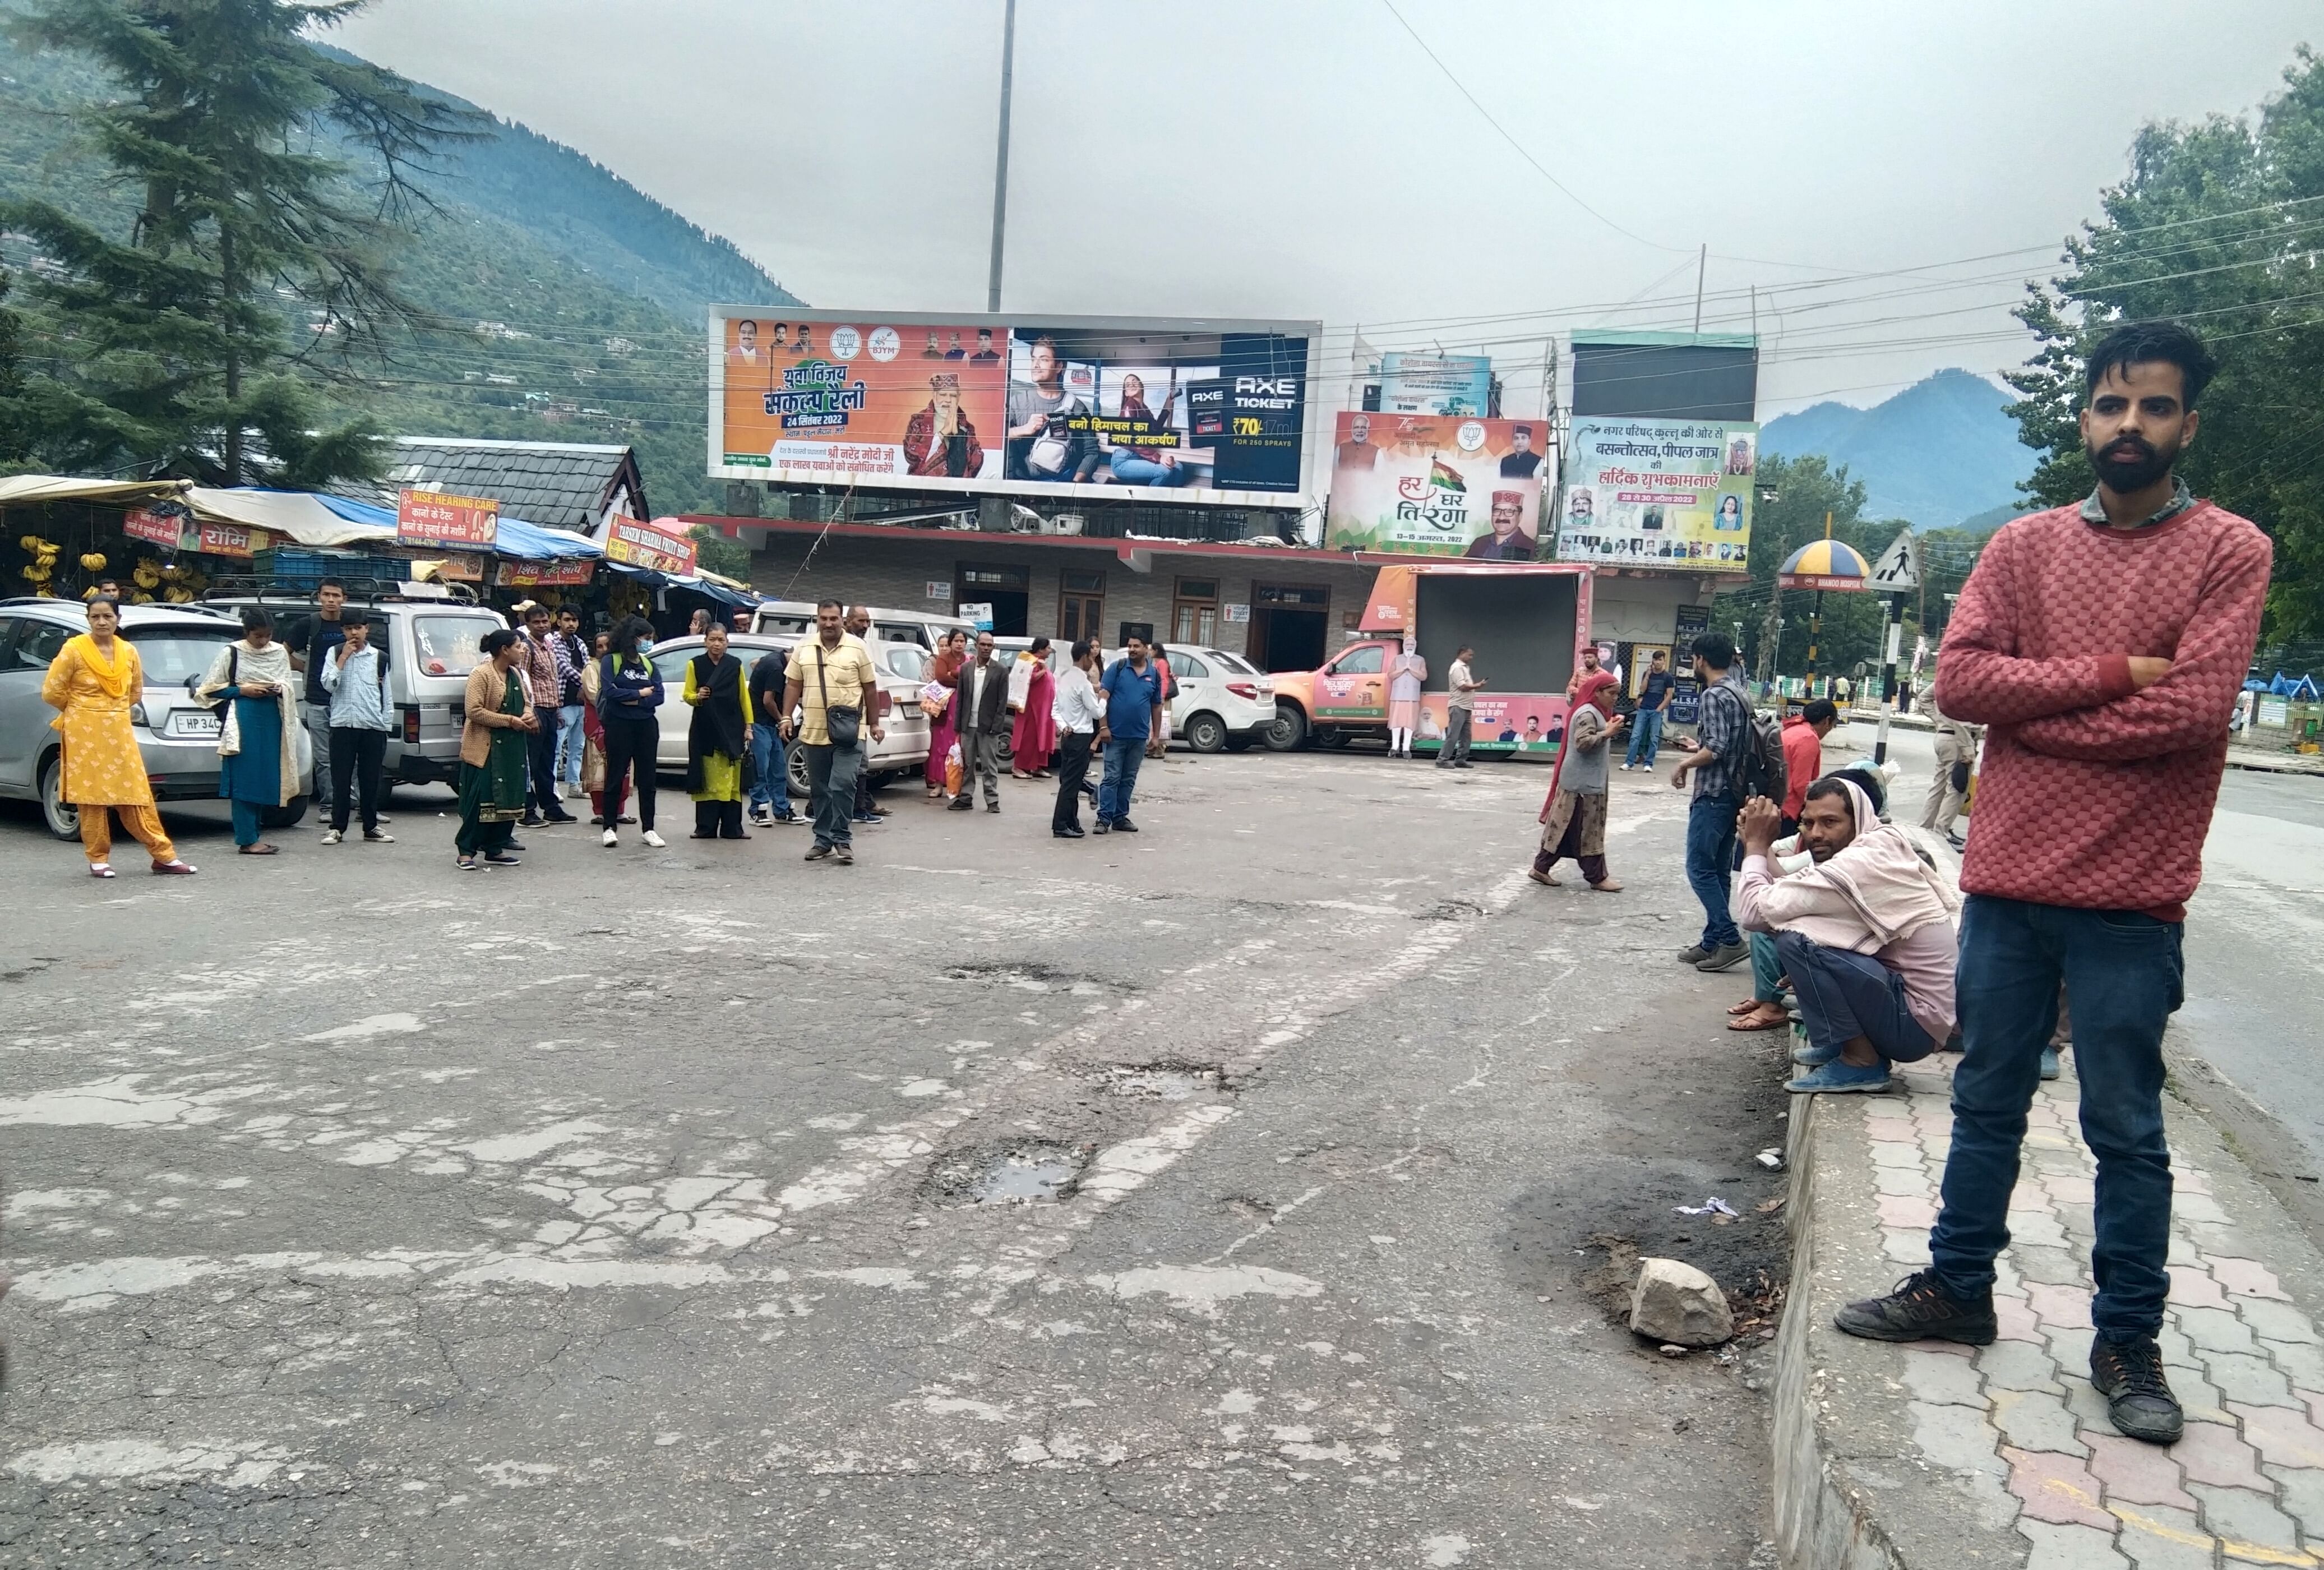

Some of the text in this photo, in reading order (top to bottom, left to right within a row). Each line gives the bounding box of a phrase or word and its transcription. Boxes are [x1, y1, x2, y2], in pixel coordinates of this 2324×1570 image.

[782, 361, 849, 390] युवा विजय
[1235, 377, 1296, 395] AXE
[763, 379, 867, 415] संकल्प रैली
[1192, 391, 1224, 403] AXE
[1235, 398, 1295, 409] TICKET
[787, 414, 843, 427] 24 सितंबर 2022
[1068, 417, 1148, 432] बनो हिमाचल का
[1111, 433, 1177, 446] नया आकर्षण
[1604, 426, 1624, 436] नगर
[1655, 428, 1679, 441] कुल्लू
[1681, 425, 1694, 438] की
[1695, 426, 1713, 439] ओर
[1715, 427, 1724, 439] से
[1399, 440, 1414, 449] अमृत
[1662, 442, 1694, 459] पीपल
[1695, 446, 1720, 459] जात्र
[828, 445, 839, 459] श्री
[841, 446, 860, 460] नरेंद्र
[862, 447, 881, 461] मोदी
[883, 448, 895, 461] जी
[779, 459, 791, 469] एक
[792, 459, 811, 470] लाख
[836, 460, 845, 472] को
[847, 461, 875, 473] संबोधित
[876, 462, 894, 474] करेंगे
[1650, 460, 1662, 469] की
[1598, 467, 1639, 486] हार्दिक
[413, 492, 497, 511] RISE HEARING CARE
[1440, 494, 1465, 506] घर
[1633, 493, 1641, 502] से
[412, 506, 454, 520] कानों के टैस्ट
[1397, 501, 1469, 531] तिरंगा
[401, 520, 415, 532] कानों
[417, 521, 424, 532] के
[424, 522, 441, 537] सुनाई
[441, 523, 449, 535] की
[404, 537, 441, 547] 78144-47647
[618, 525, 691, 560] TARSEM SHARMA FRUIT SHOP
[517, 564, 539, 575] शिव
[1840, 579, 1860, 588] HOSPITAL
[187, 718, 198, 728] HP
